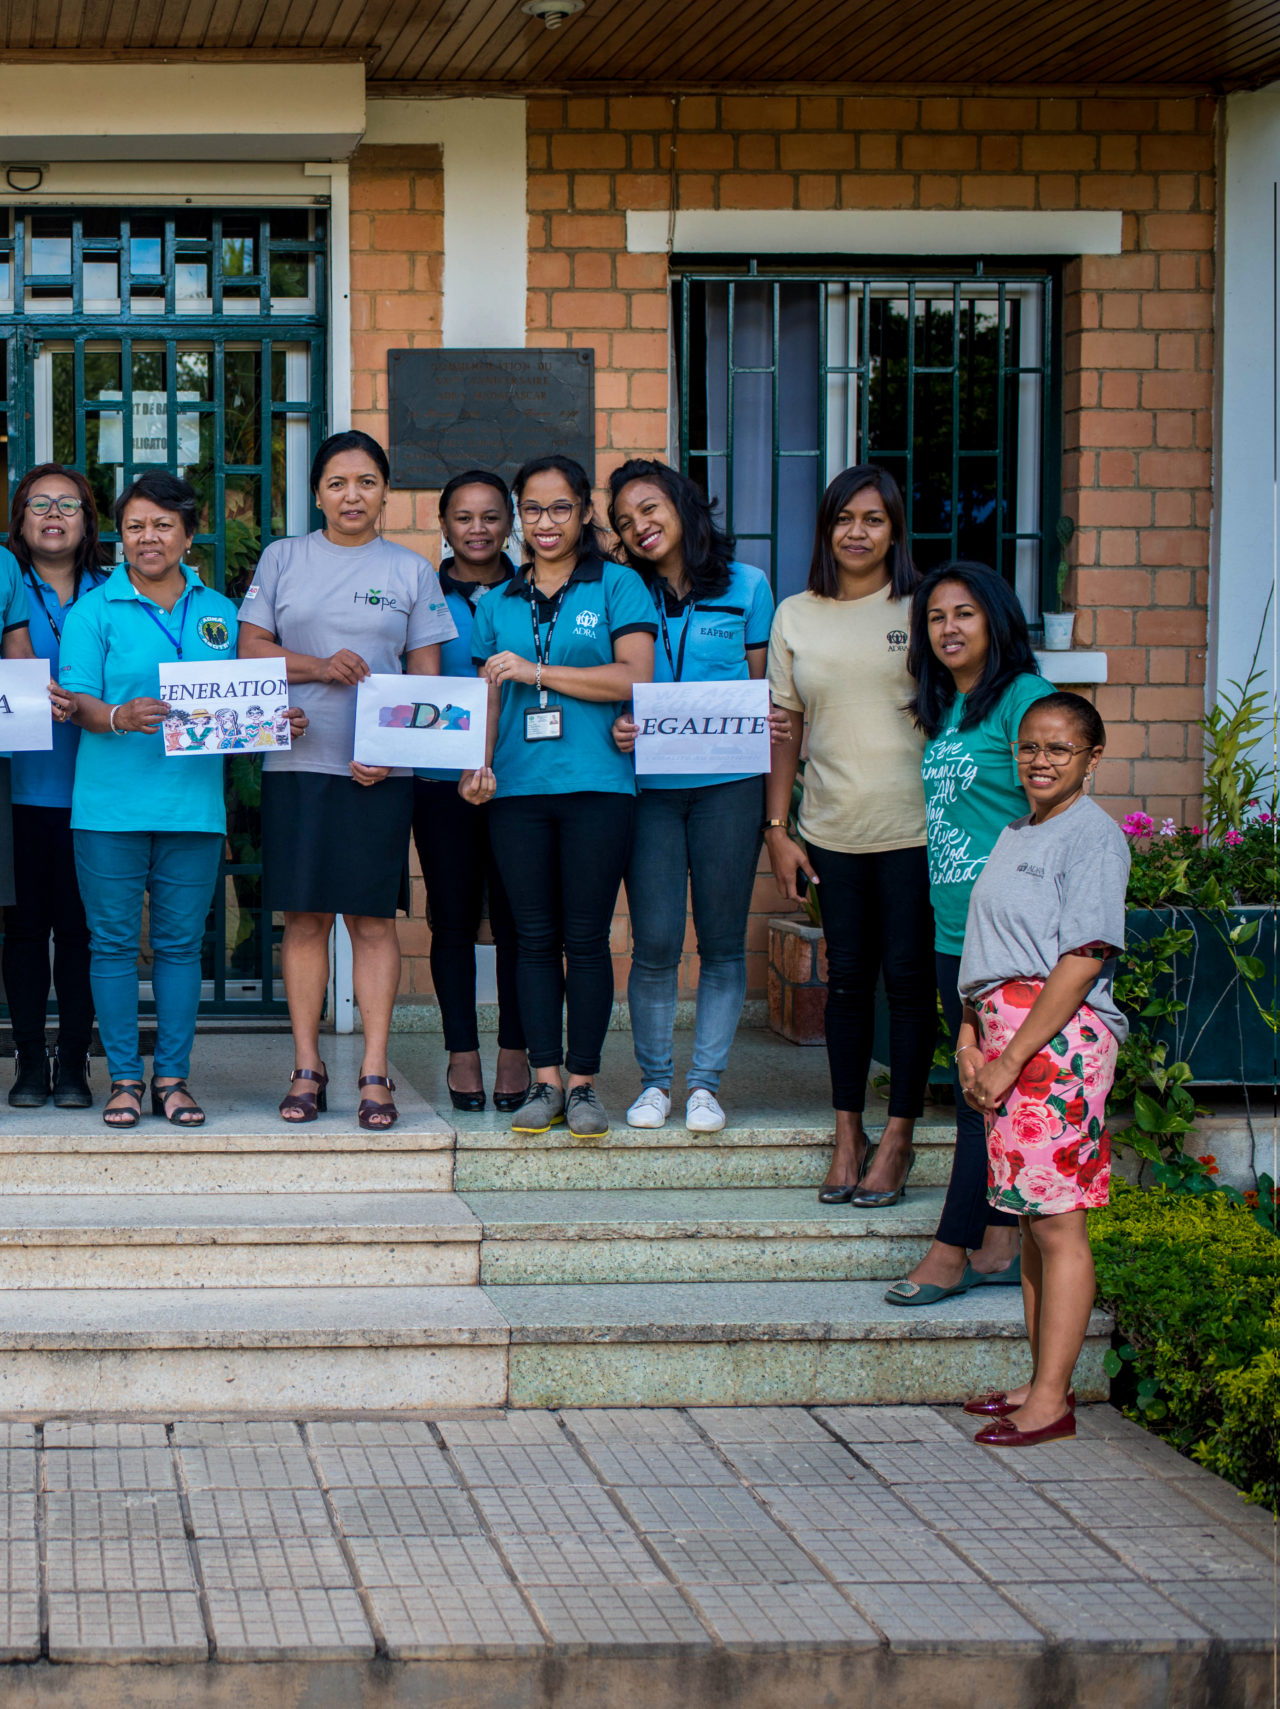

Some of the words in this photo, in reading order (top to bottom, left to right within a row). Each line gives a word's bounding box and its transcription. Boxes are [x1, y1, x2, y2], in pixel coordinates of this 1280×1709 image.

[474, 391, 547, 400] MADAGASCAR
[353, 591, 397, 611] Hope
[572, 627, 596, 639] ADRA
[160, 679, 287, 701] GENERATION
[640, 716, 768, 735] EGALITE
[921, 753, 978, 791] umanity
